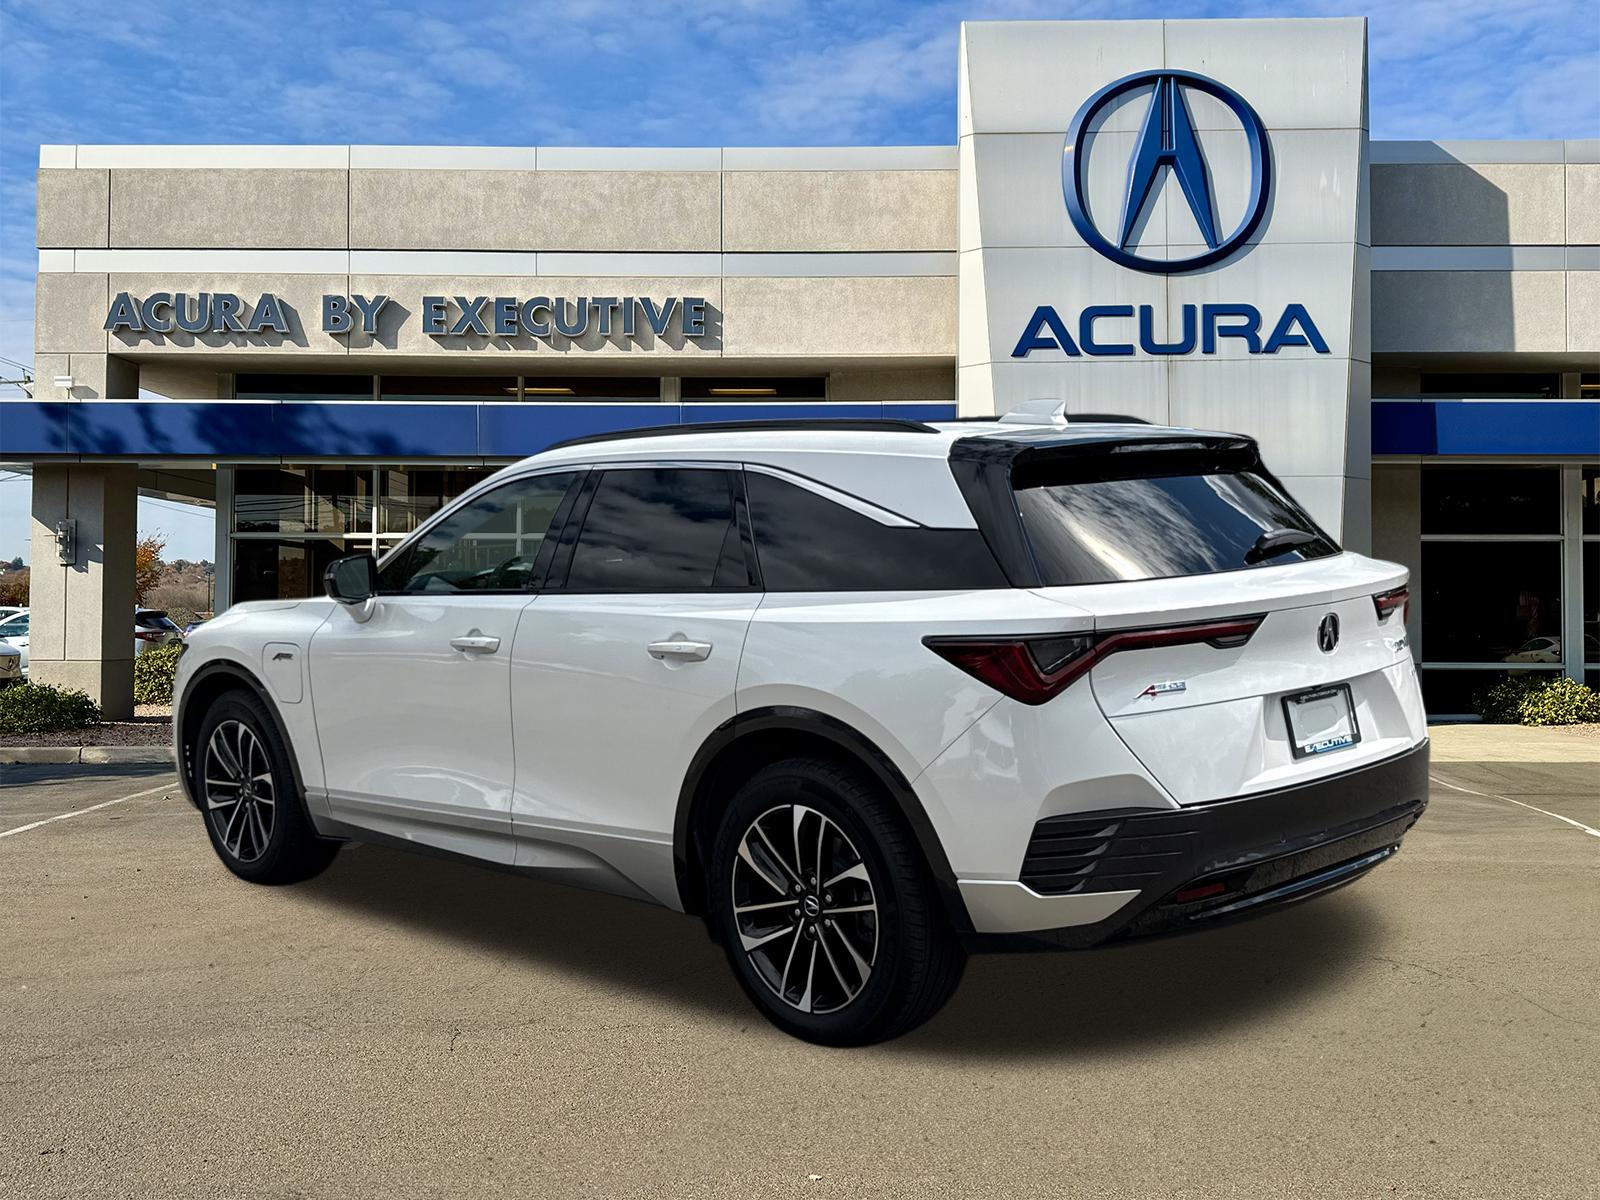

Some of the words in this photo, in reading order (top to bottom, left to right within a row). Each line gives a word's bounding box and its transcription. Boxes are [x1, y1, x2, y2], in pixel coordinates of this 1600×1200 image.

[103, 292, 291, 333] ACURA
[322, 294, 391, 334] BY
[422, 296, 706, 337] EXECUTIVE
[1011, 303, 1331, 357] ACURA
